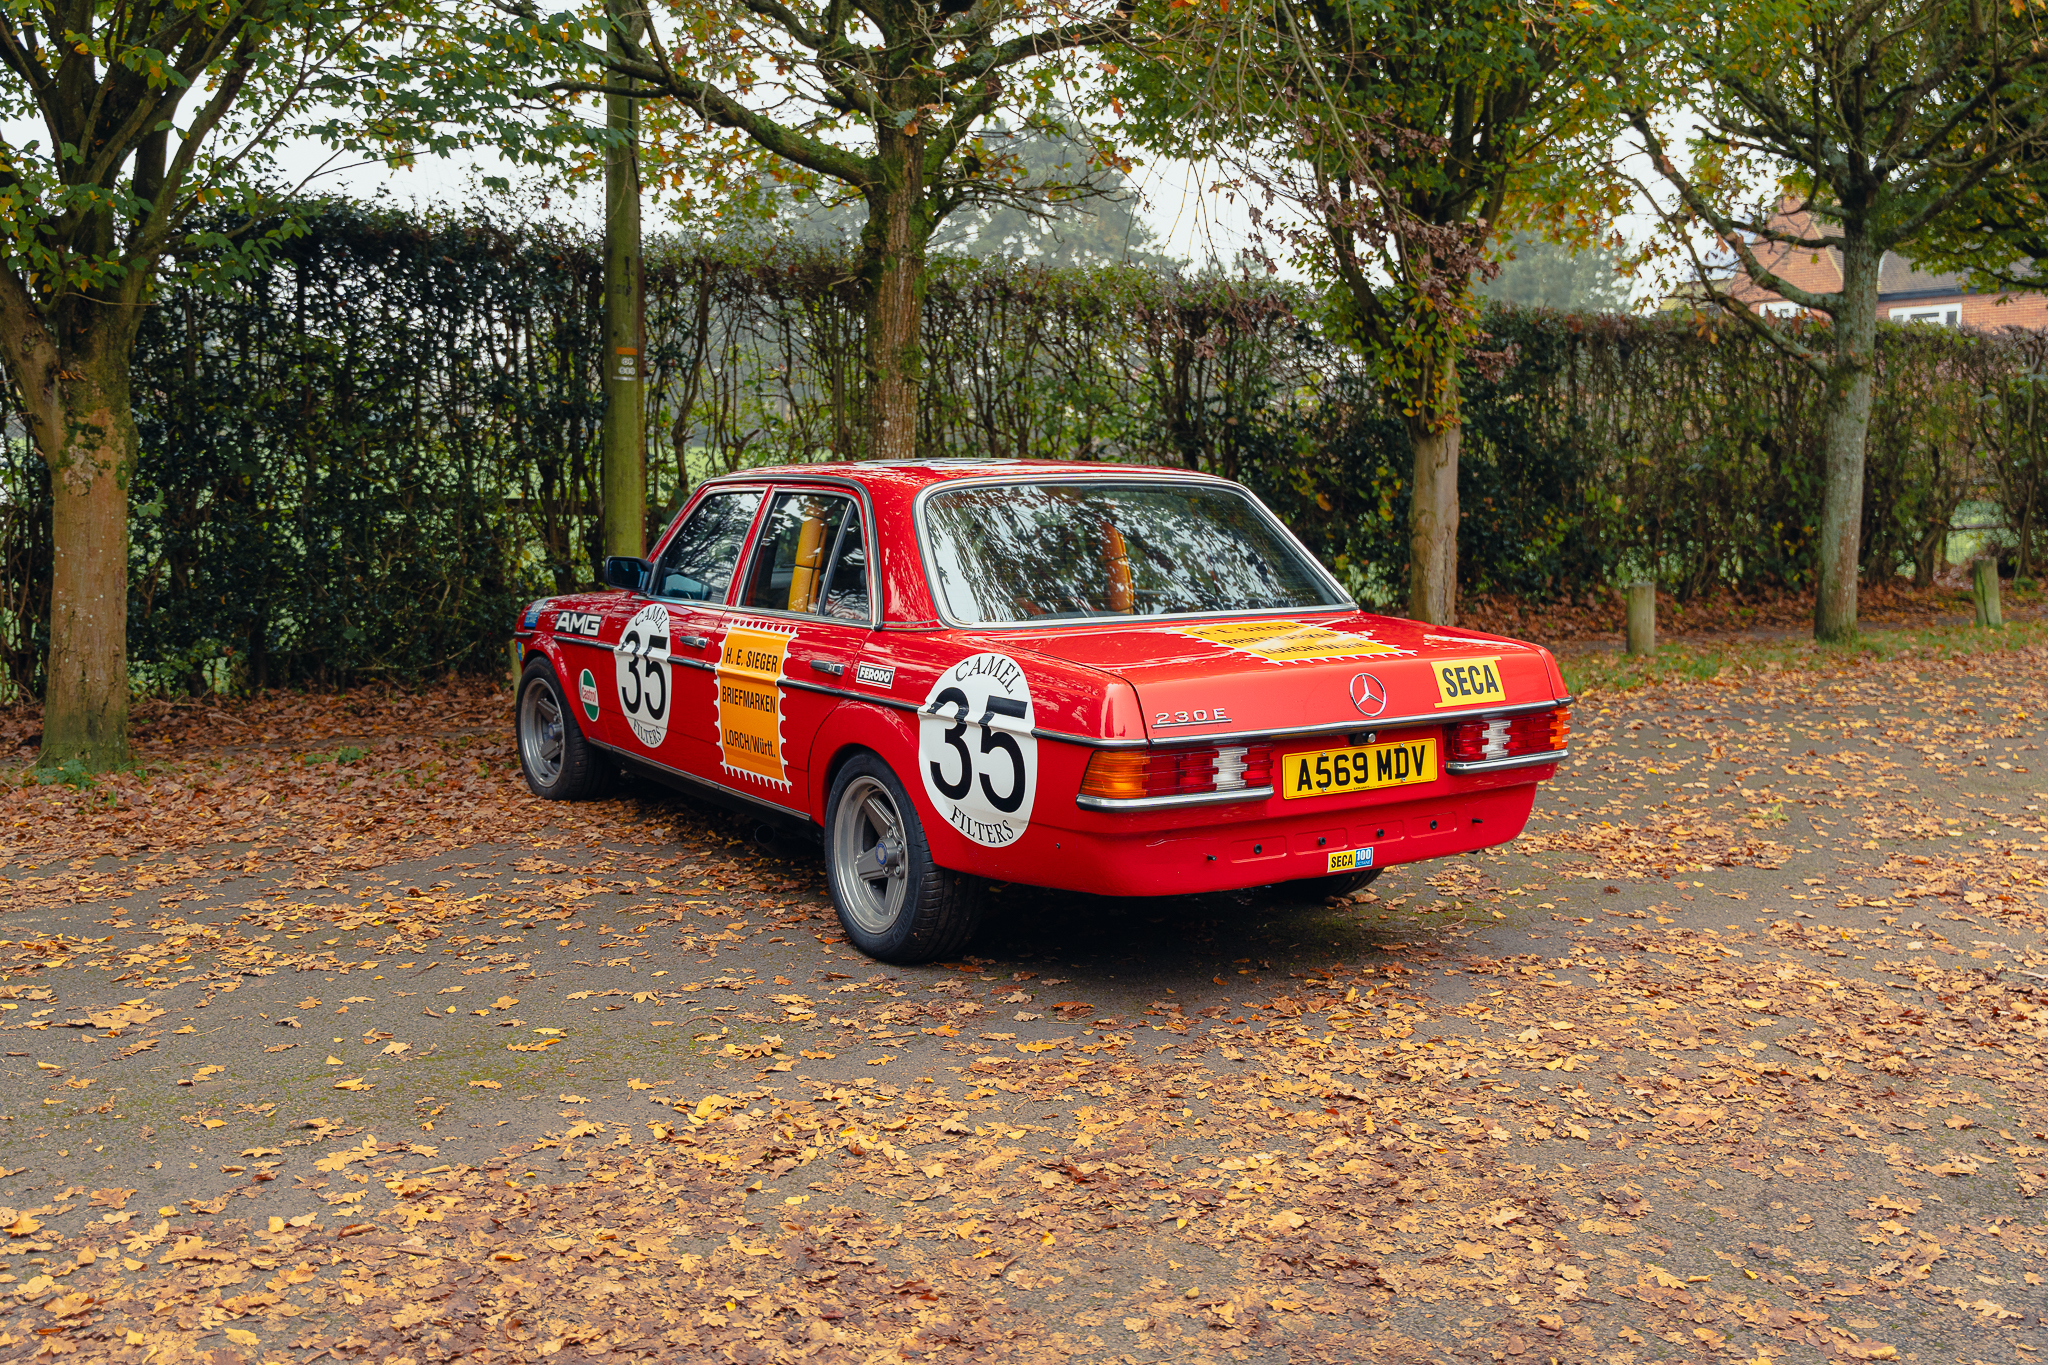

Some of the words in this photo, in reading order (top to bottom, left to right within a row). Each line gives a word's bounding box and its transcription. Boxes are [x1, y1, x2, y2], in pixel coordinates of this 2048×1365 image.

[555, 612, 602, 636] AMG
[635, 605, 668, 633] CAMEL
[725, 648, 735, 664] H.
[736, 649, 743, 666] E.
[746, 652, 778, 673] SIEGER
[859, 666, 891, 683] FERODO
[619, 630, 668, 720] 35
[955, 655, 1021, 695] CAMEL
[1444, 663, 1500, 700] SECA
[581, 686, 597, 703] Castrol
[722, 685, 776, 714] BRIEFMARKEN
[633, 719, 662, 745] FILTERS
[928, 687, 1028, 813] 35
[1297, 752, 1369, 792] A569
[1375, 745, 1426, 782] MDV
[949, 804, 1015, 844] FILTERS
[1331, 853, 1353, 868] SECA
[1356, 849, 1372, 861] 100
